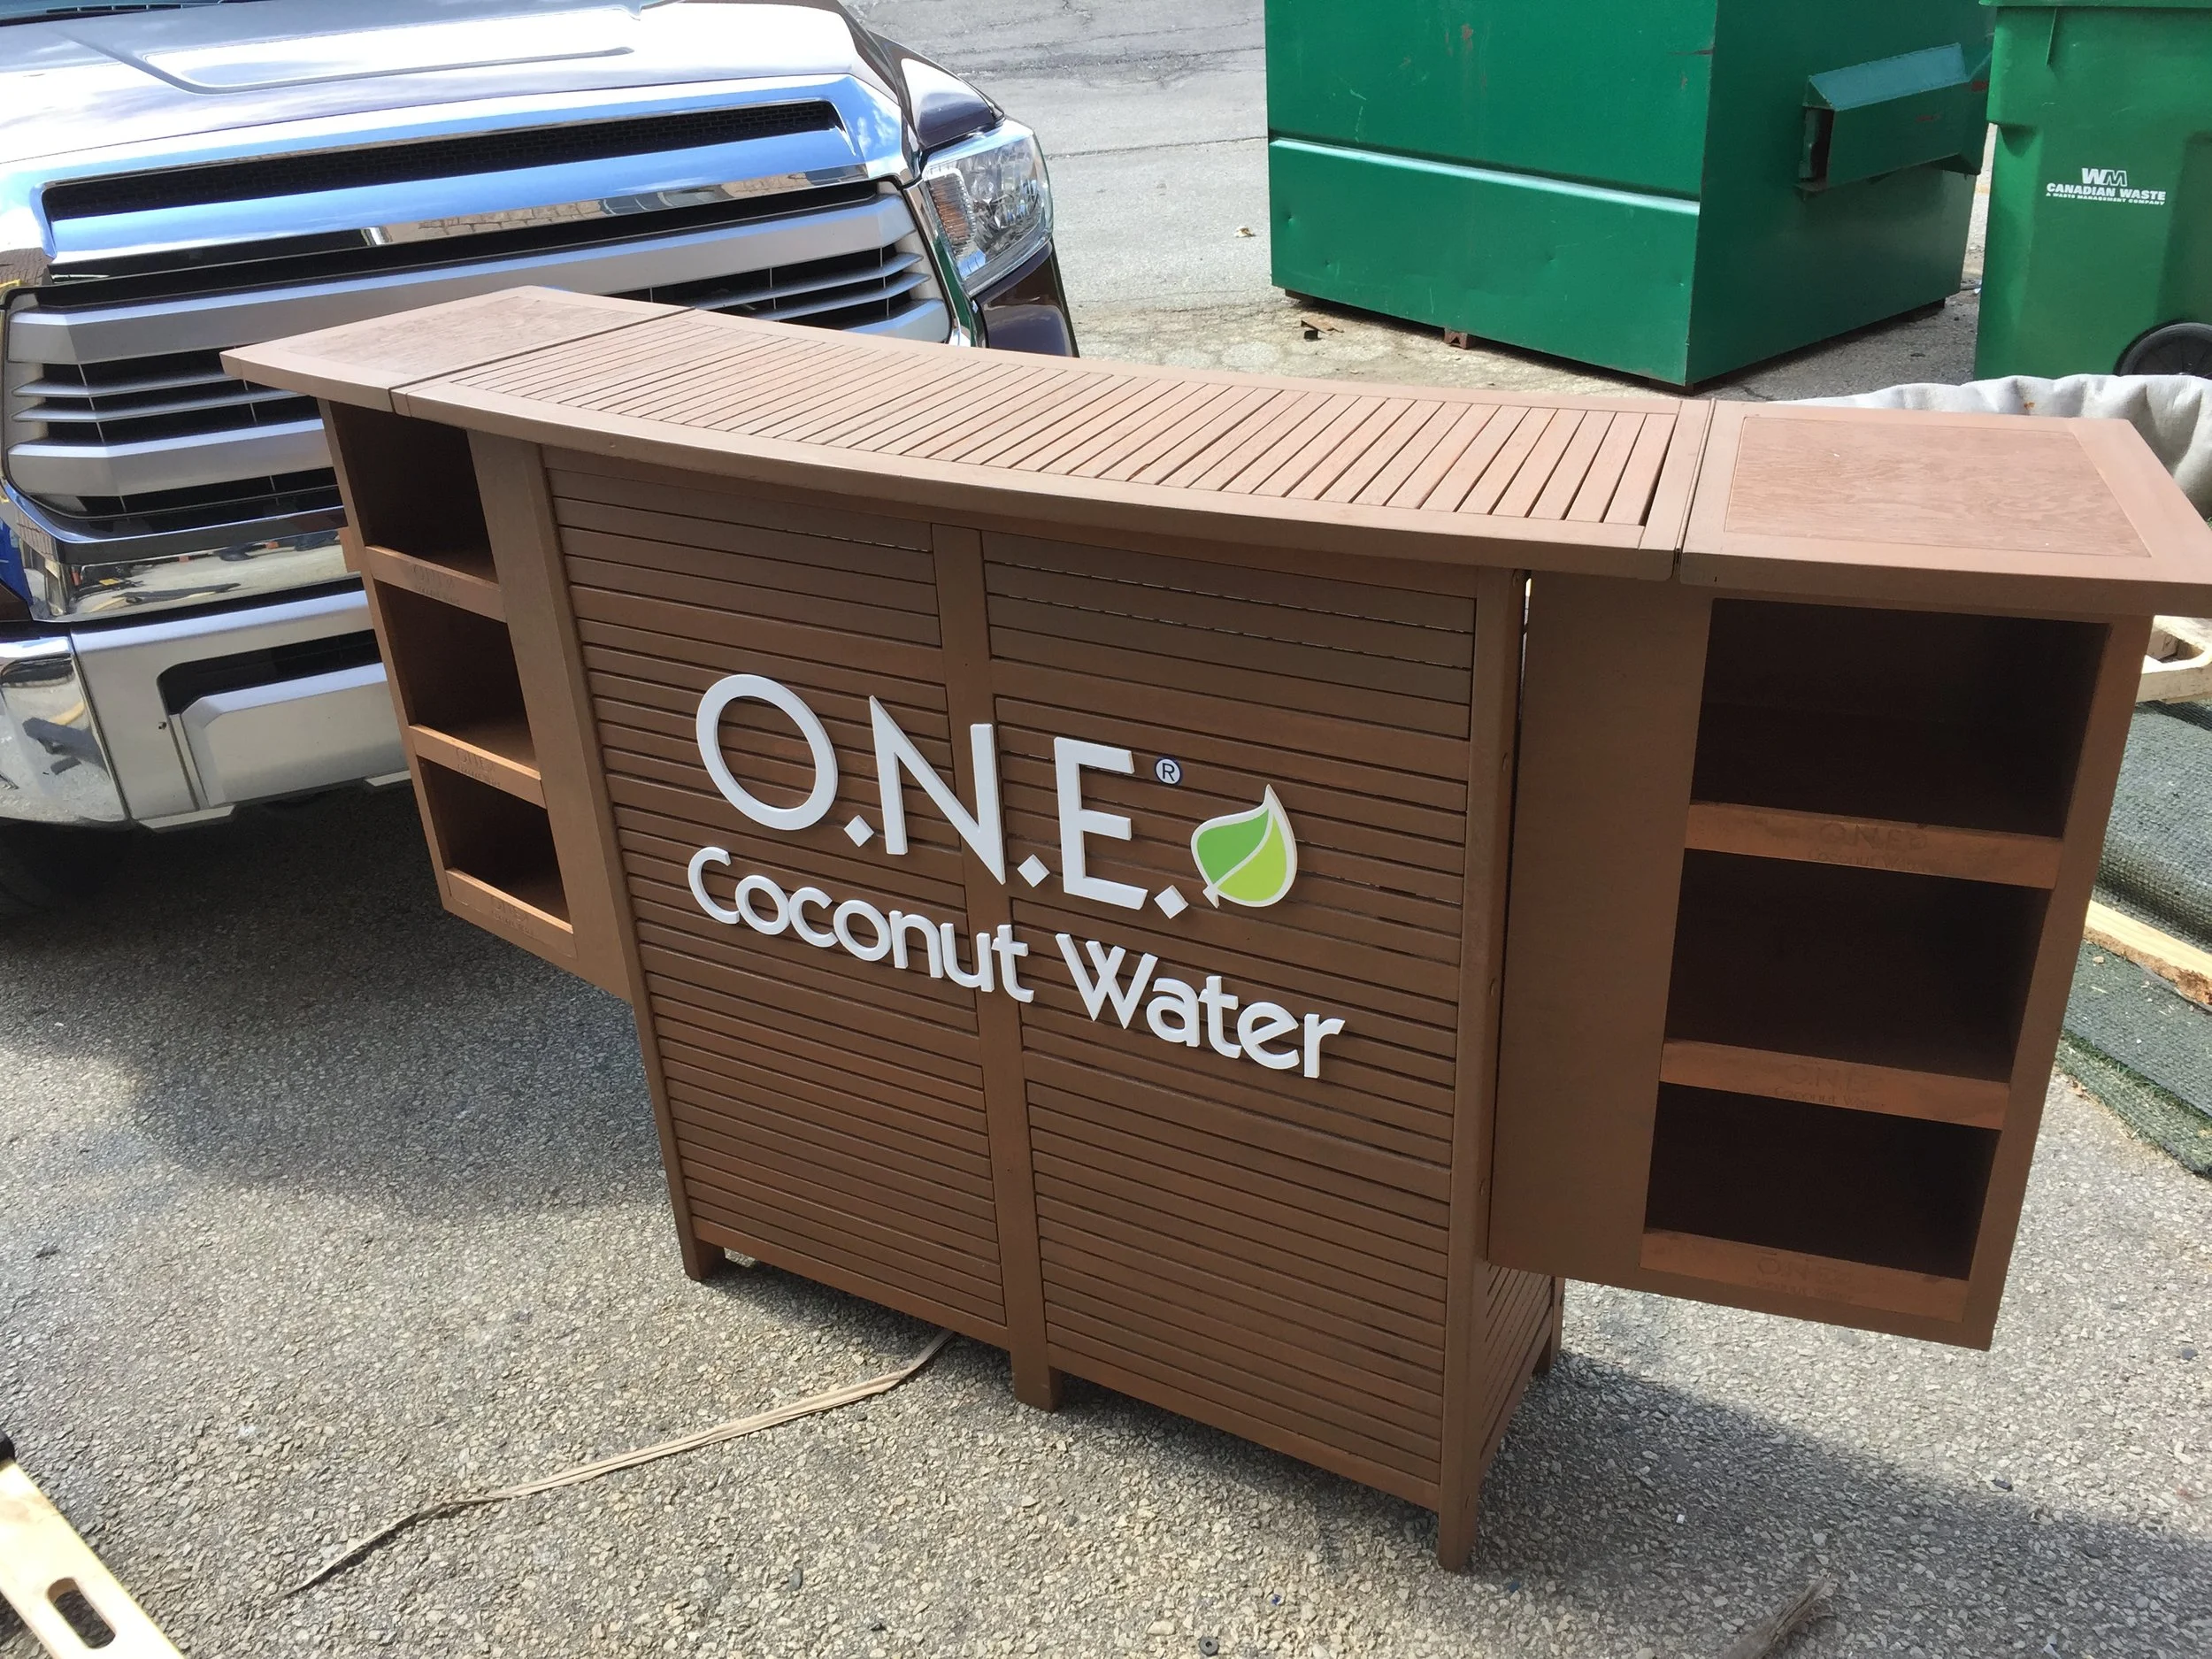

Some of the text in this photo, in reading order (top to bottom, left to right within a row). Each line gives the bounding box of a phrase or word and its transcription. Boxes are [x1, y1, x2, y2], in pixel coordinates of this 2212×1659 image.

[2046, 182, 2167, 201] CANADIAN WASTE
[2081, 167, 2128, 187] WM
[695, 673, 1188, 919] O.N.E.
[687, 846, 1345, 1079] Coconut Water
